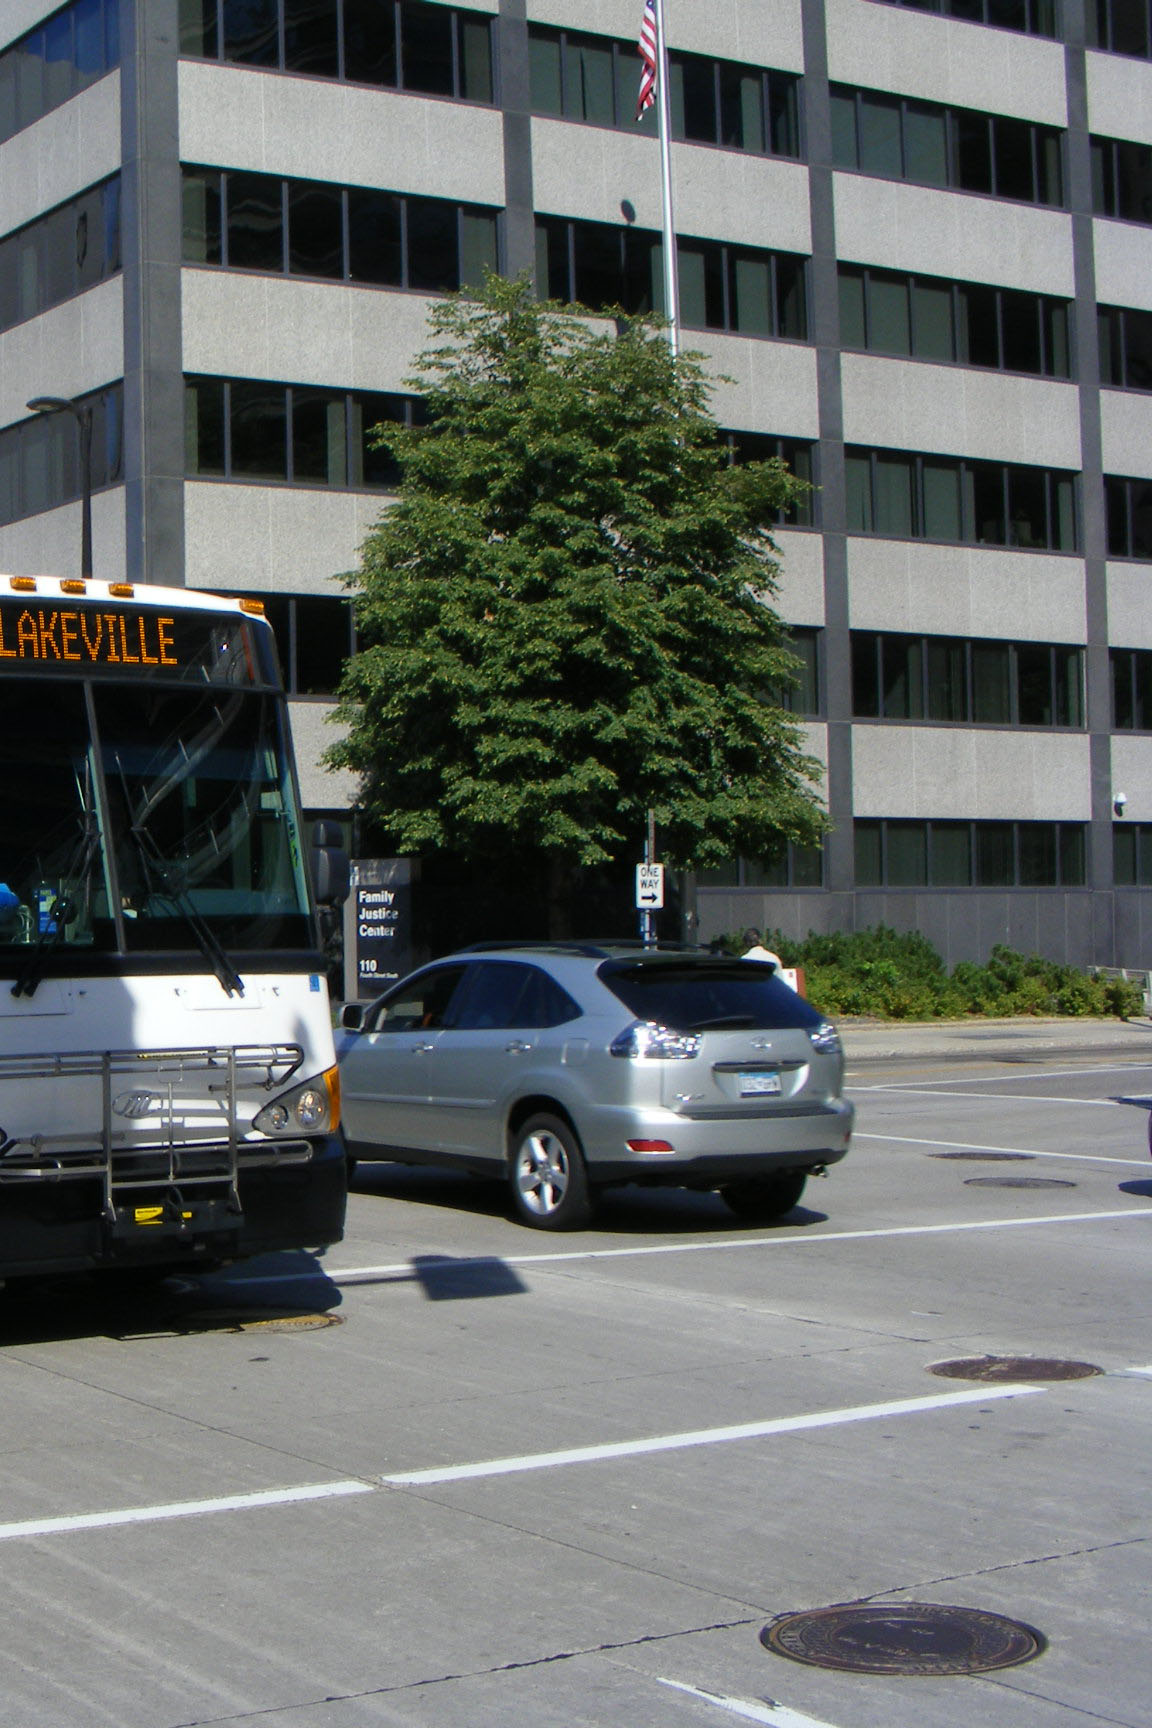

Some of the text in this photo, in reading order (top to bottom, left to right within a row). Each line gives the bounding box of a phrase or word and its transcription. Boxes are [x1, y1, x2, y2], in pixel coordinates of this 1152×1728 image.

[640, 867, 660, 878] ONE
[640, 879, 660, 889] WAY
[358, 890, 395, 905] Family
[358, 907, 400, 921] Justice
[358, 924, 395, 937] Center
[359, 960, 378, 972] 110
